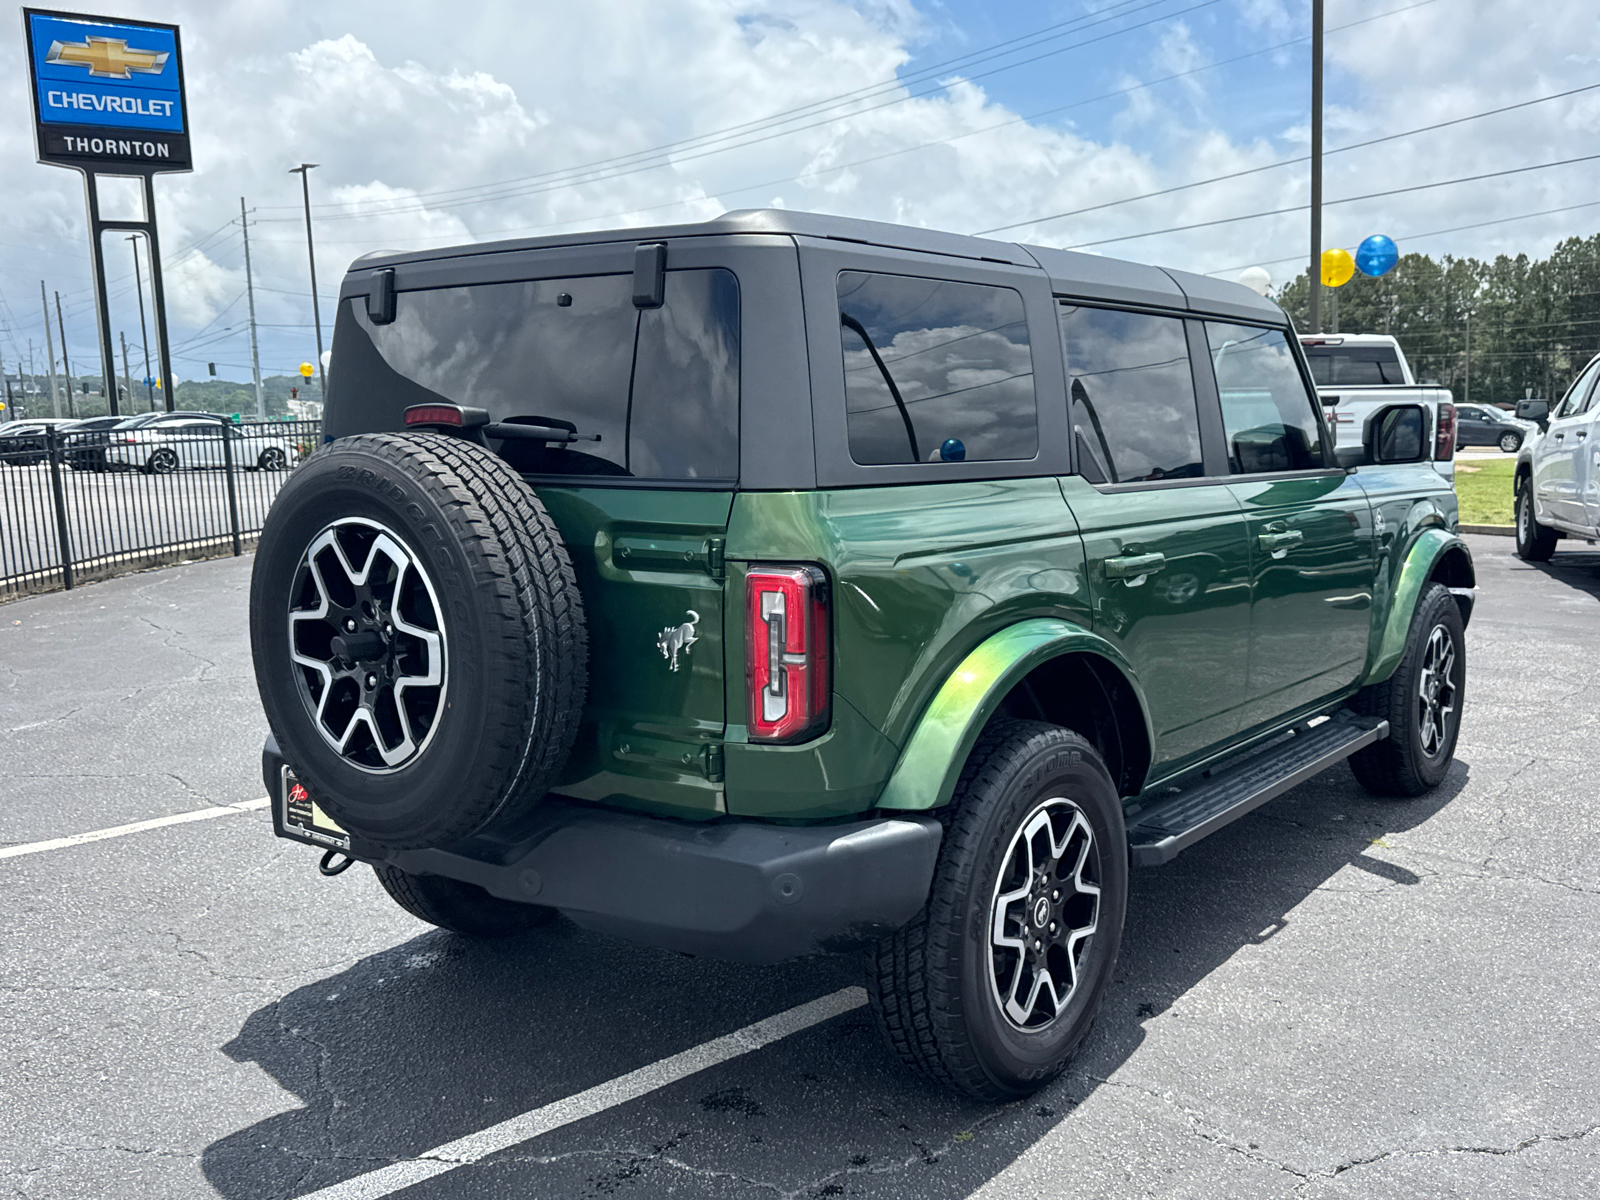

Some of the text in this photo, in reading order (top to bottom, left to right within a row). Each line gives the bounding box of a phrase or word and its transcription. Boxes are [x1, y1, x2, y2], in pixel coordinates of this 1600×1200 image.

[47, 90, 174, 117] CHEVROLET
[63, 136, 170, 158] THORNTON
[336, 464, 480, 691] BRIDGESTONE
